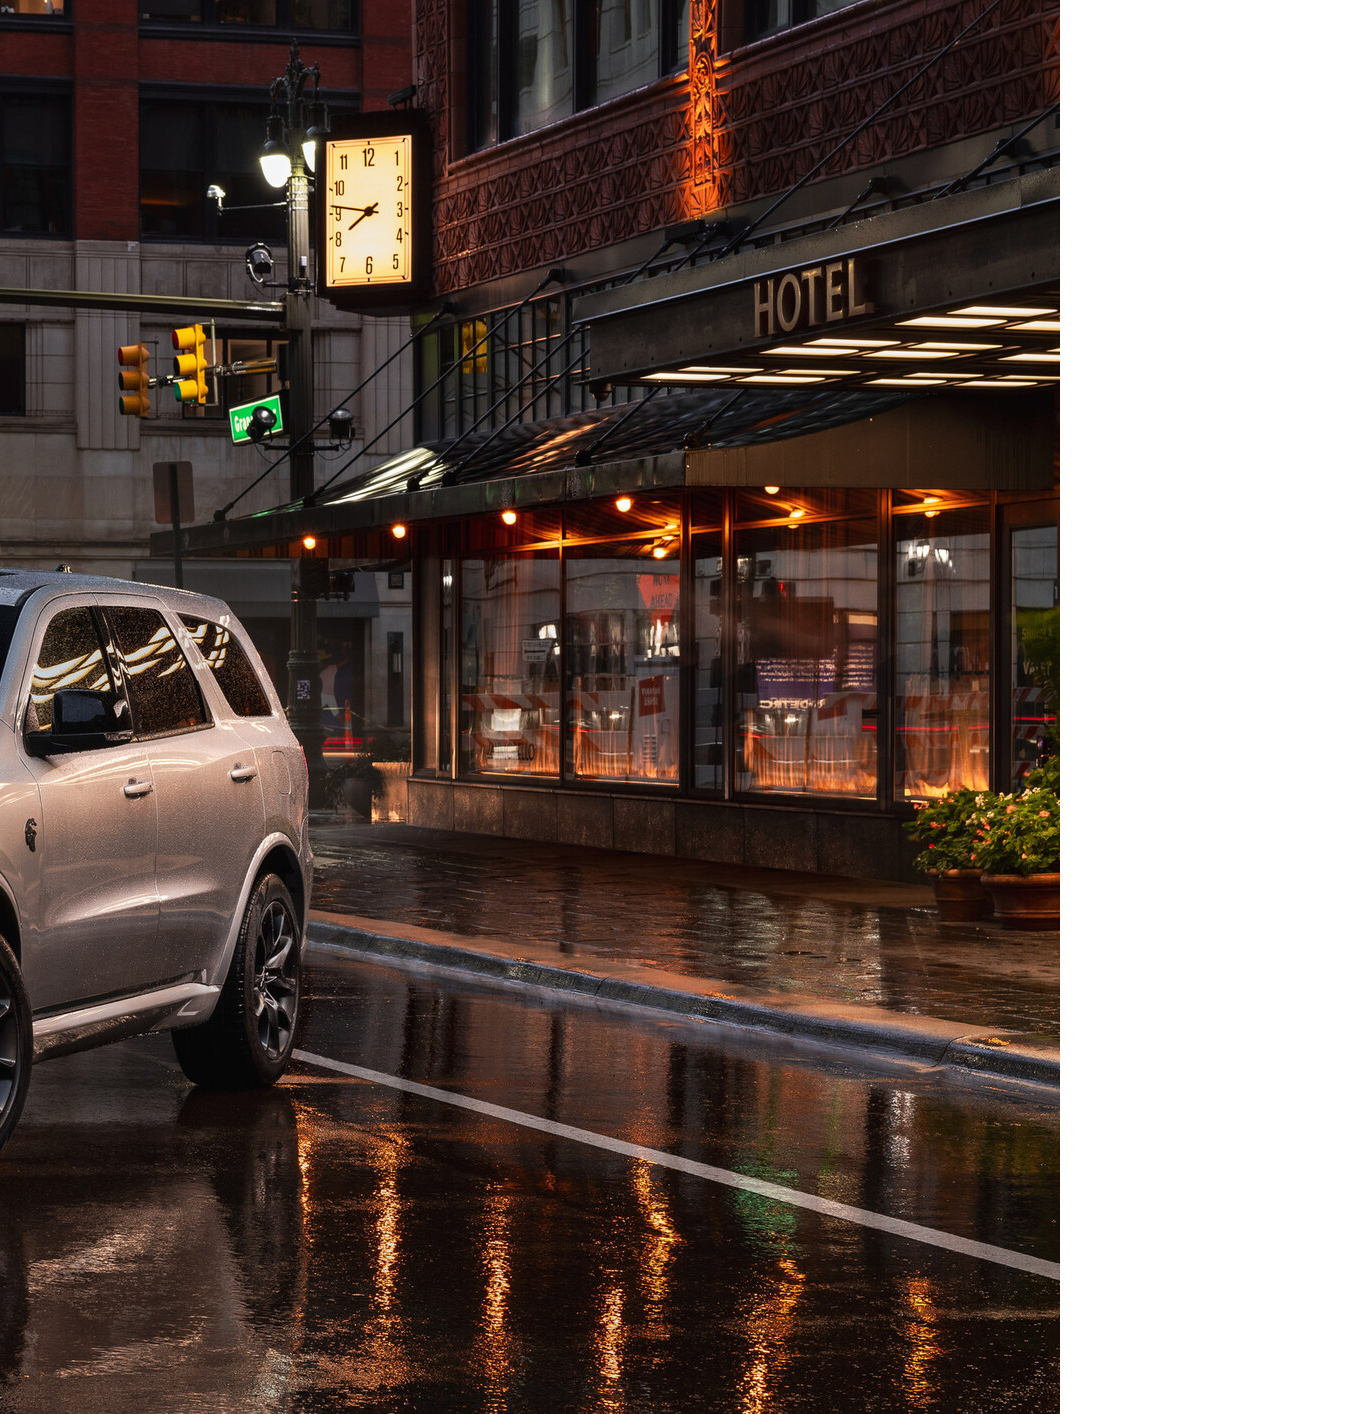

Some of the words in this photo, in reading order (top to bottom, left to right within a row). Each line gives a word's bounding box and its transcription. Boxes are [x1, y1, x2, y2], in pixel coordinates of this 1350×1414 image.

[339, 154, 348, 170] 11
[362, 147, 375, 167] 12
[394, 150, 399, 166] 1
[334, 180, 345, 196] 10
[396, 175, 403, 192] 2
[335, 206, 342, 222] 9
[396, 201, 403, 218] 3
[335, 231, 342, 247] 8
[396, 227, 403, 244] 4
[339, 256, 346, 273] 7
[365, 255, 373, 275] 6
[392, 253, 399, 270] 5
[753, 257, 872, 338] HOTEL
